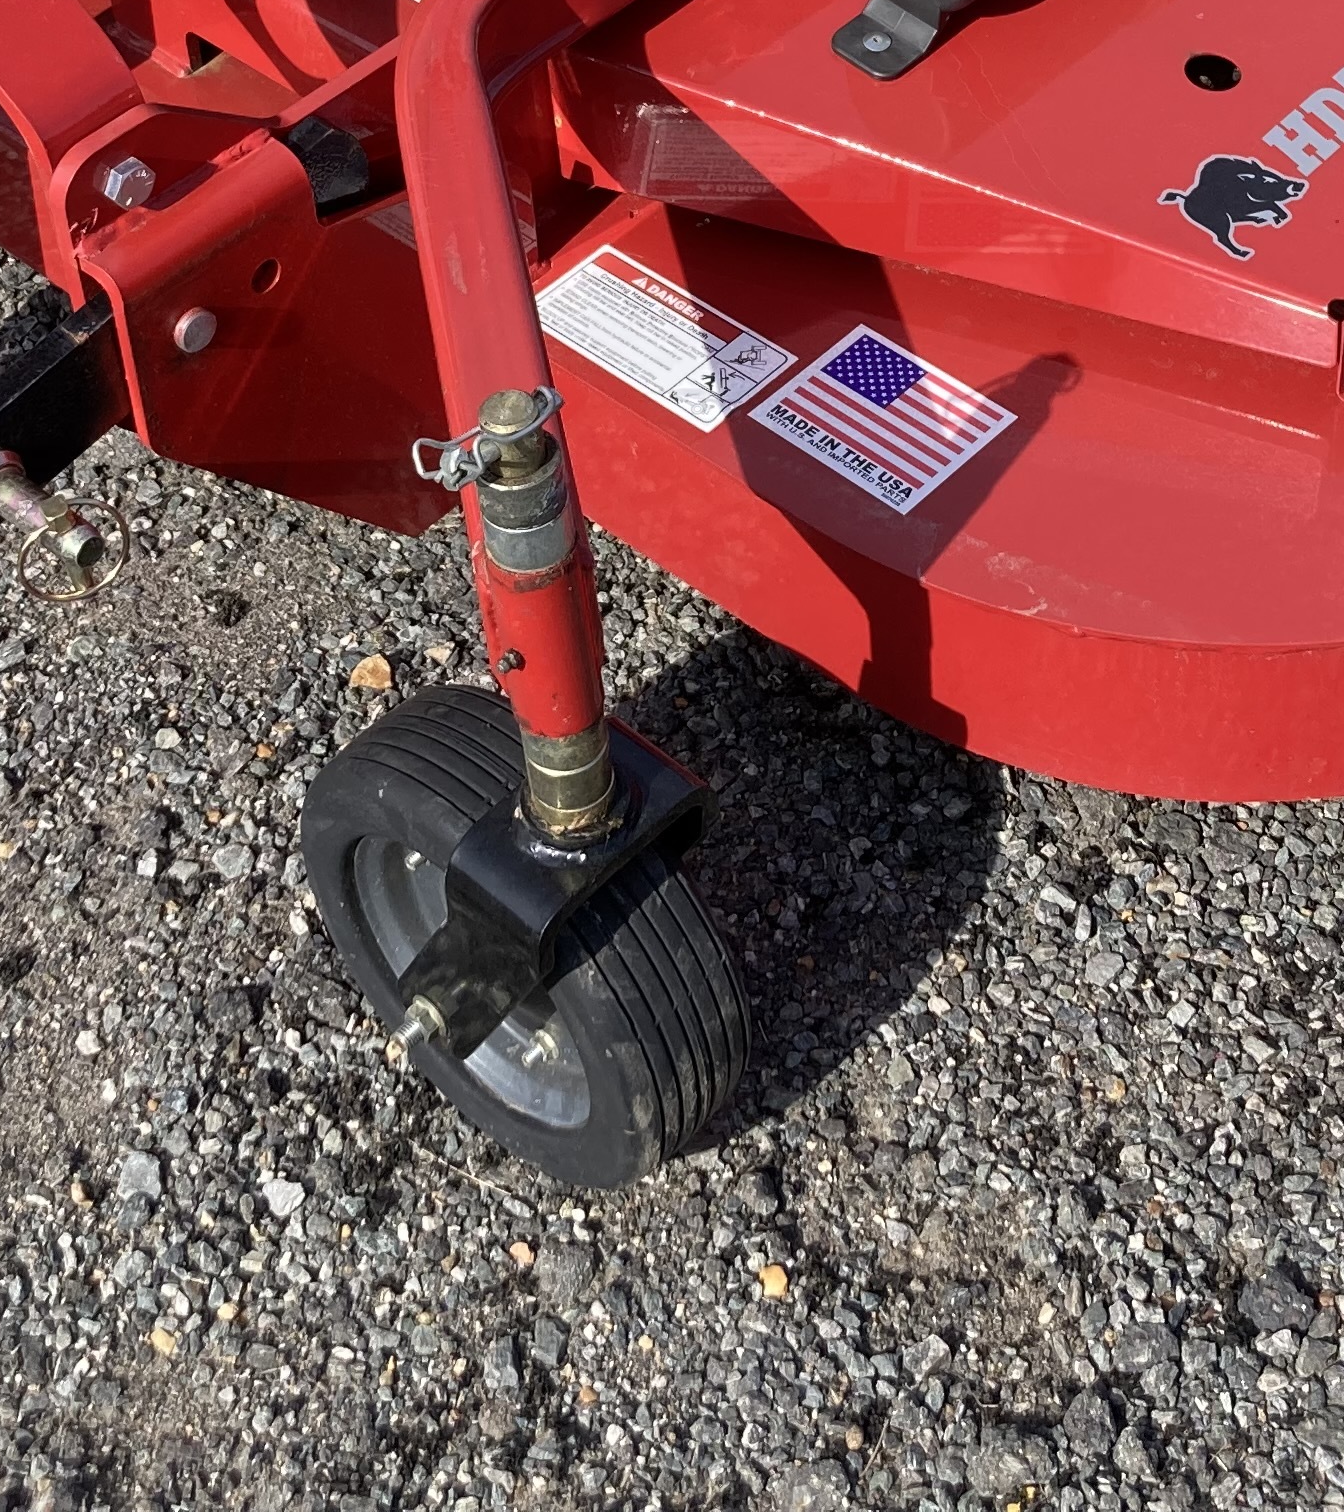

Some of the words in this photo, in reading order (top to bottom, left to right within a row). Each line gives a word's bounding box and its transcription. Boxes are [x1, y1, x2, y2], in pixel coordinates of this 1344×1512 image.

[599, 272, 631, 294] Crushing
[629, 290, 655, 308] Hazard
[656, 307, 679, 322] Injury
[686, 324, 710, 340] Death
[645, 283, 705, 322] DANGER
[764, 411, 789, 428] WITH
[787, 426, 807, 440] U.S.
[806, 438, 828, 453] AND
[826, 451, 875, 483] IMPORTED
[874, 481, 907, 503] PARTS
[769, 404, 820, 438] MADE
[817, 434, 841, 451] IN
[838, 447, 878, 474] THE
[875, 470, 916, 498] USA
